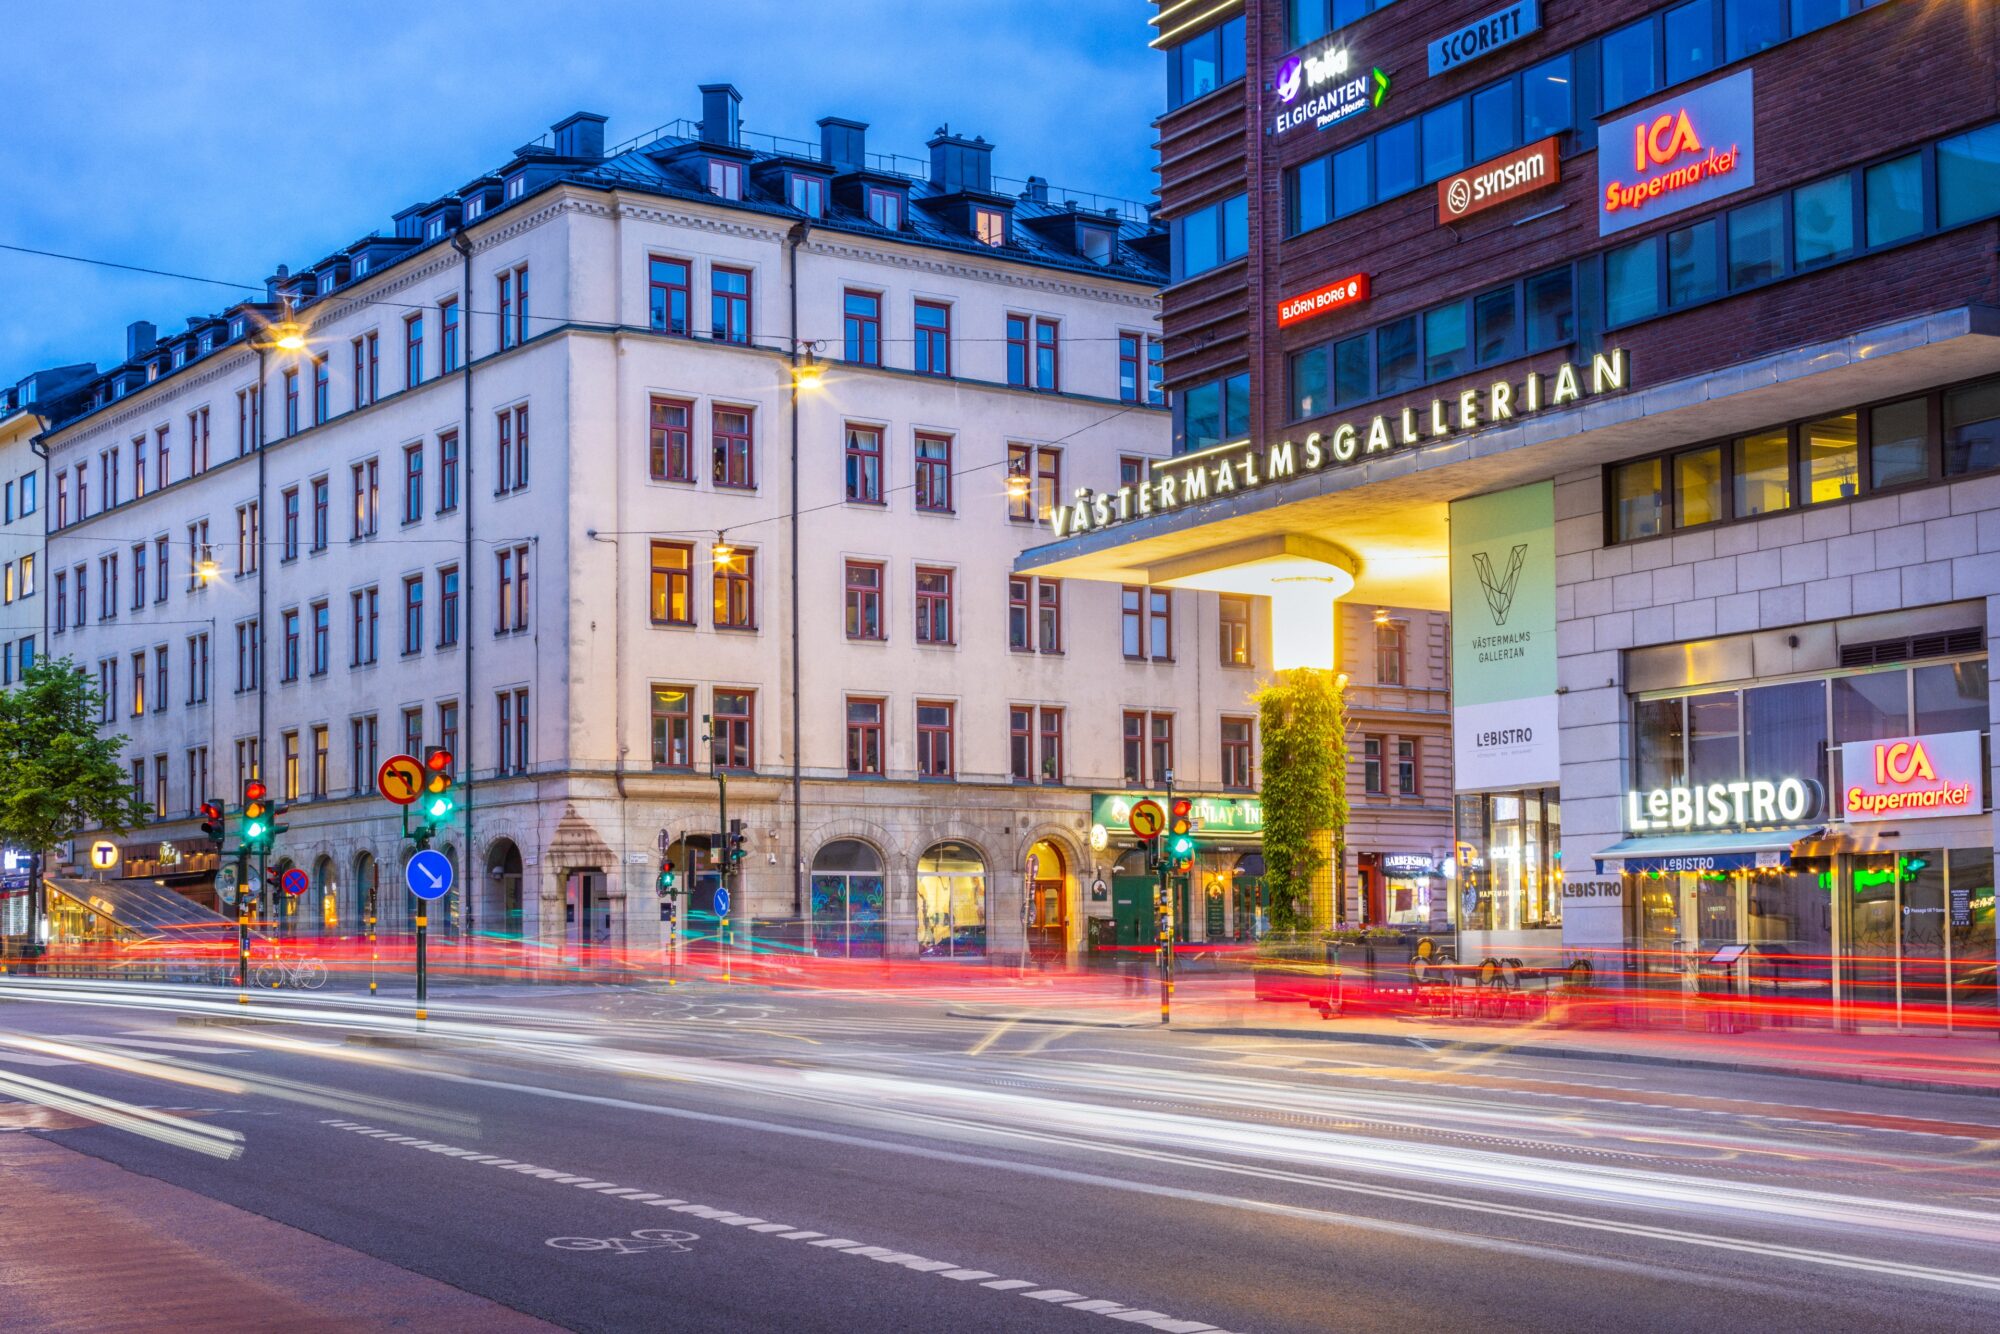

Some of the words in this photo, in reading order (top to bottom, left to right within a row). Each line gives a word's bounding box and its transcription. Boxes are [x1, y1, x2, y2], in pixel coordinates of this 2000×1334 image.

[1441, 8, 1521, 66] SCORETT
[1277, 76, 1367, 133] ELGIGANTEN
[1317, 109, 1341, 127] Phone
[1341, 98, 1366, 117] House
[1635, 107, 1702, 173] ICA
[1473, 153, 1545, 201] SYNSAM
[1605, 143, 1739, 212] Supermarket
[1282, 298, 1315, 320] BJÖRN
[1316, 287, 1345, 308] BORG
[1050, 347, 1630, 537] VÄSTERMALMSGALLERIAN
[1472, 631, 1531, 649] VÄSTERMALMS
[1478, 647, 1525, 663] GALLERIAN
[1875, 741, 1937, 785] ICA
[1847, 780, 1971, 815] Supermarket
[97, 846, 113, 865] T
[1385, 855, 1432, 867] BARBERSHOP
